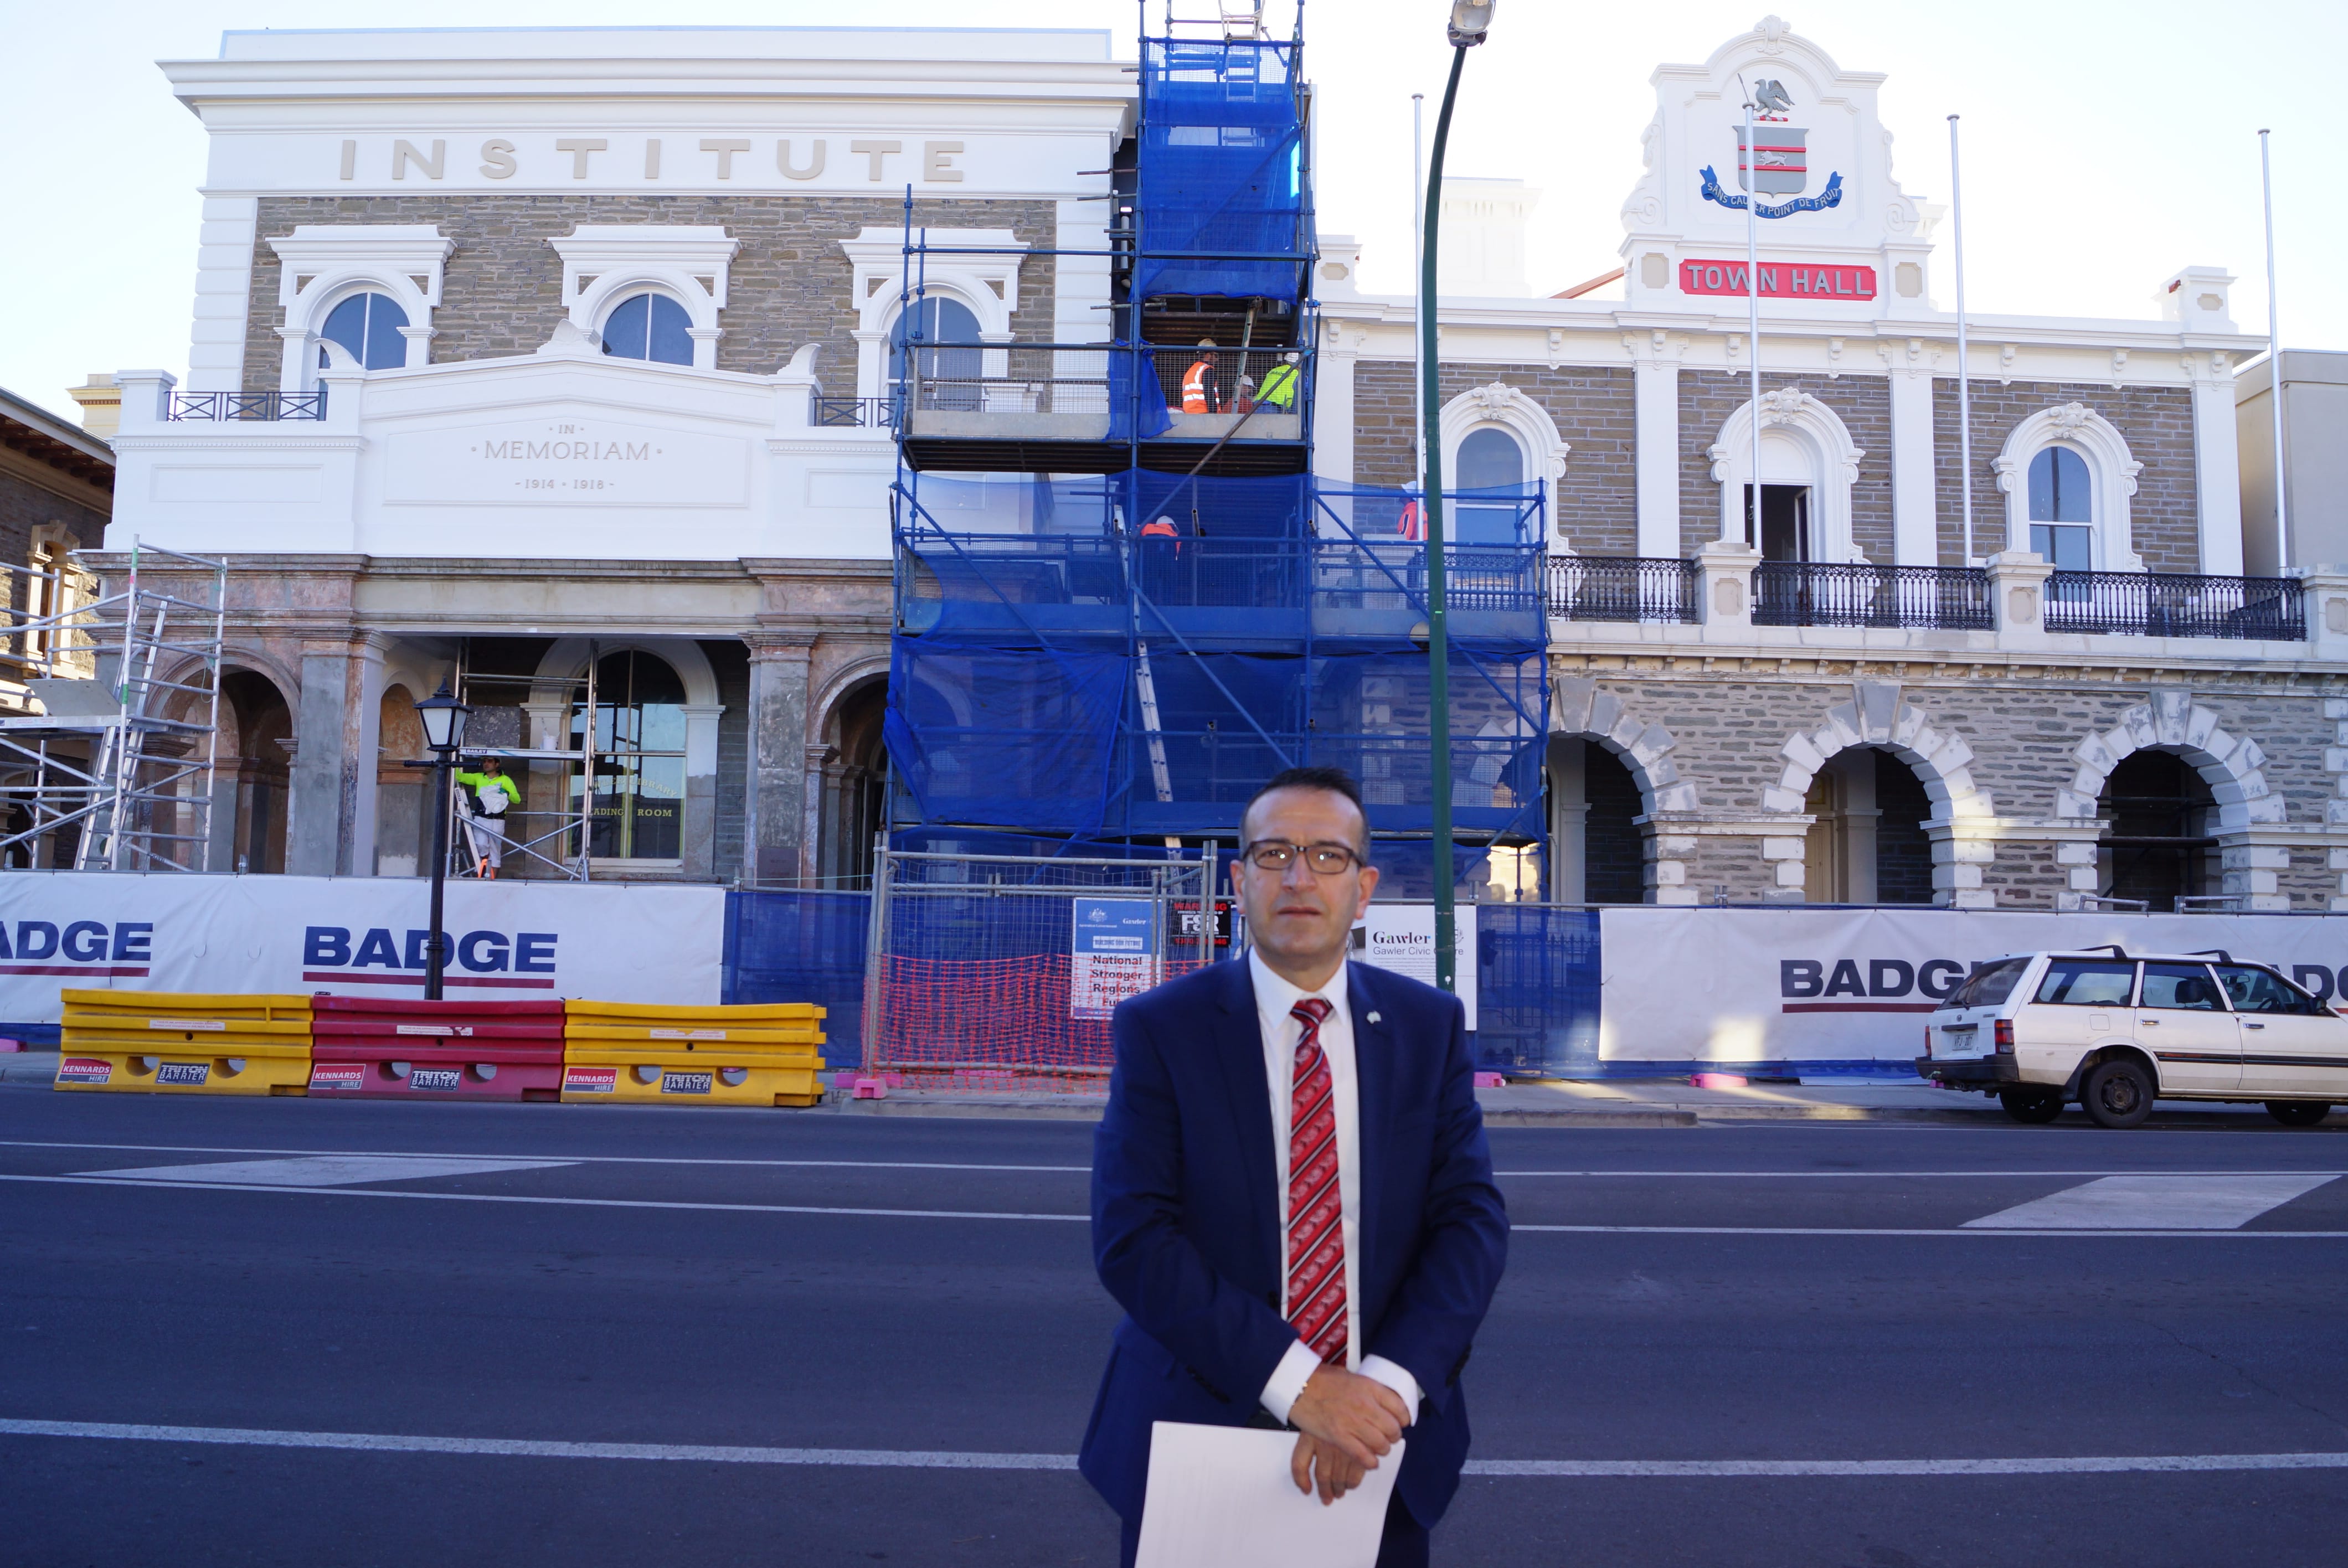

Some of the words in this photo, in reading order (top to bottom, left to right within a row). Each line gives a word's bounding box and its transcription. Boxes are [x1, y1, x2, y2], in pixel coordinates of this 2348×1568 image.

[339, 138, 964, 182] INSTITUTE
[1707, 183, 1728, 203] SANS
[1768, 201, 1795, 216] POINT
[1799, 198, 1811, 207] DE
[1814, 188, 1840, 208] FRUIT
[1687, 265, 1777, 292] TOWN
[1792, 270, 1872, 295] HALL
[558, 424, 574, 434] IN
[485, 440, 650, 460] MEMORIAM
[630, 777, 678, 798] LIBRARY
[1373, 931, 1431, 944] Gawler
[303, 926, 558, 973] BADGE
[1373, 947, 1405, 955] Gawler
[1408, 947, 1430, 955] Civic
[1093, 955, 1142, 965] National
[1092, 969, 1142, 981] Stronger
[1780, 959, 1986, 999] BADG
[1093, 984, 1140, 995] Regions
[63, 1065, 110, 1074] KENNARDS
[162, 1065, 208, 1073] TRITON
[159, 1072, 205, 1080] BARRIER
[413, 1071, 460, 1079] TRITON
[567, 1075, 614, 1083] KENNARDS
[665, 1074, 711, 1082] TRITON
[412, 1079, 457, 1087] BARRIER
